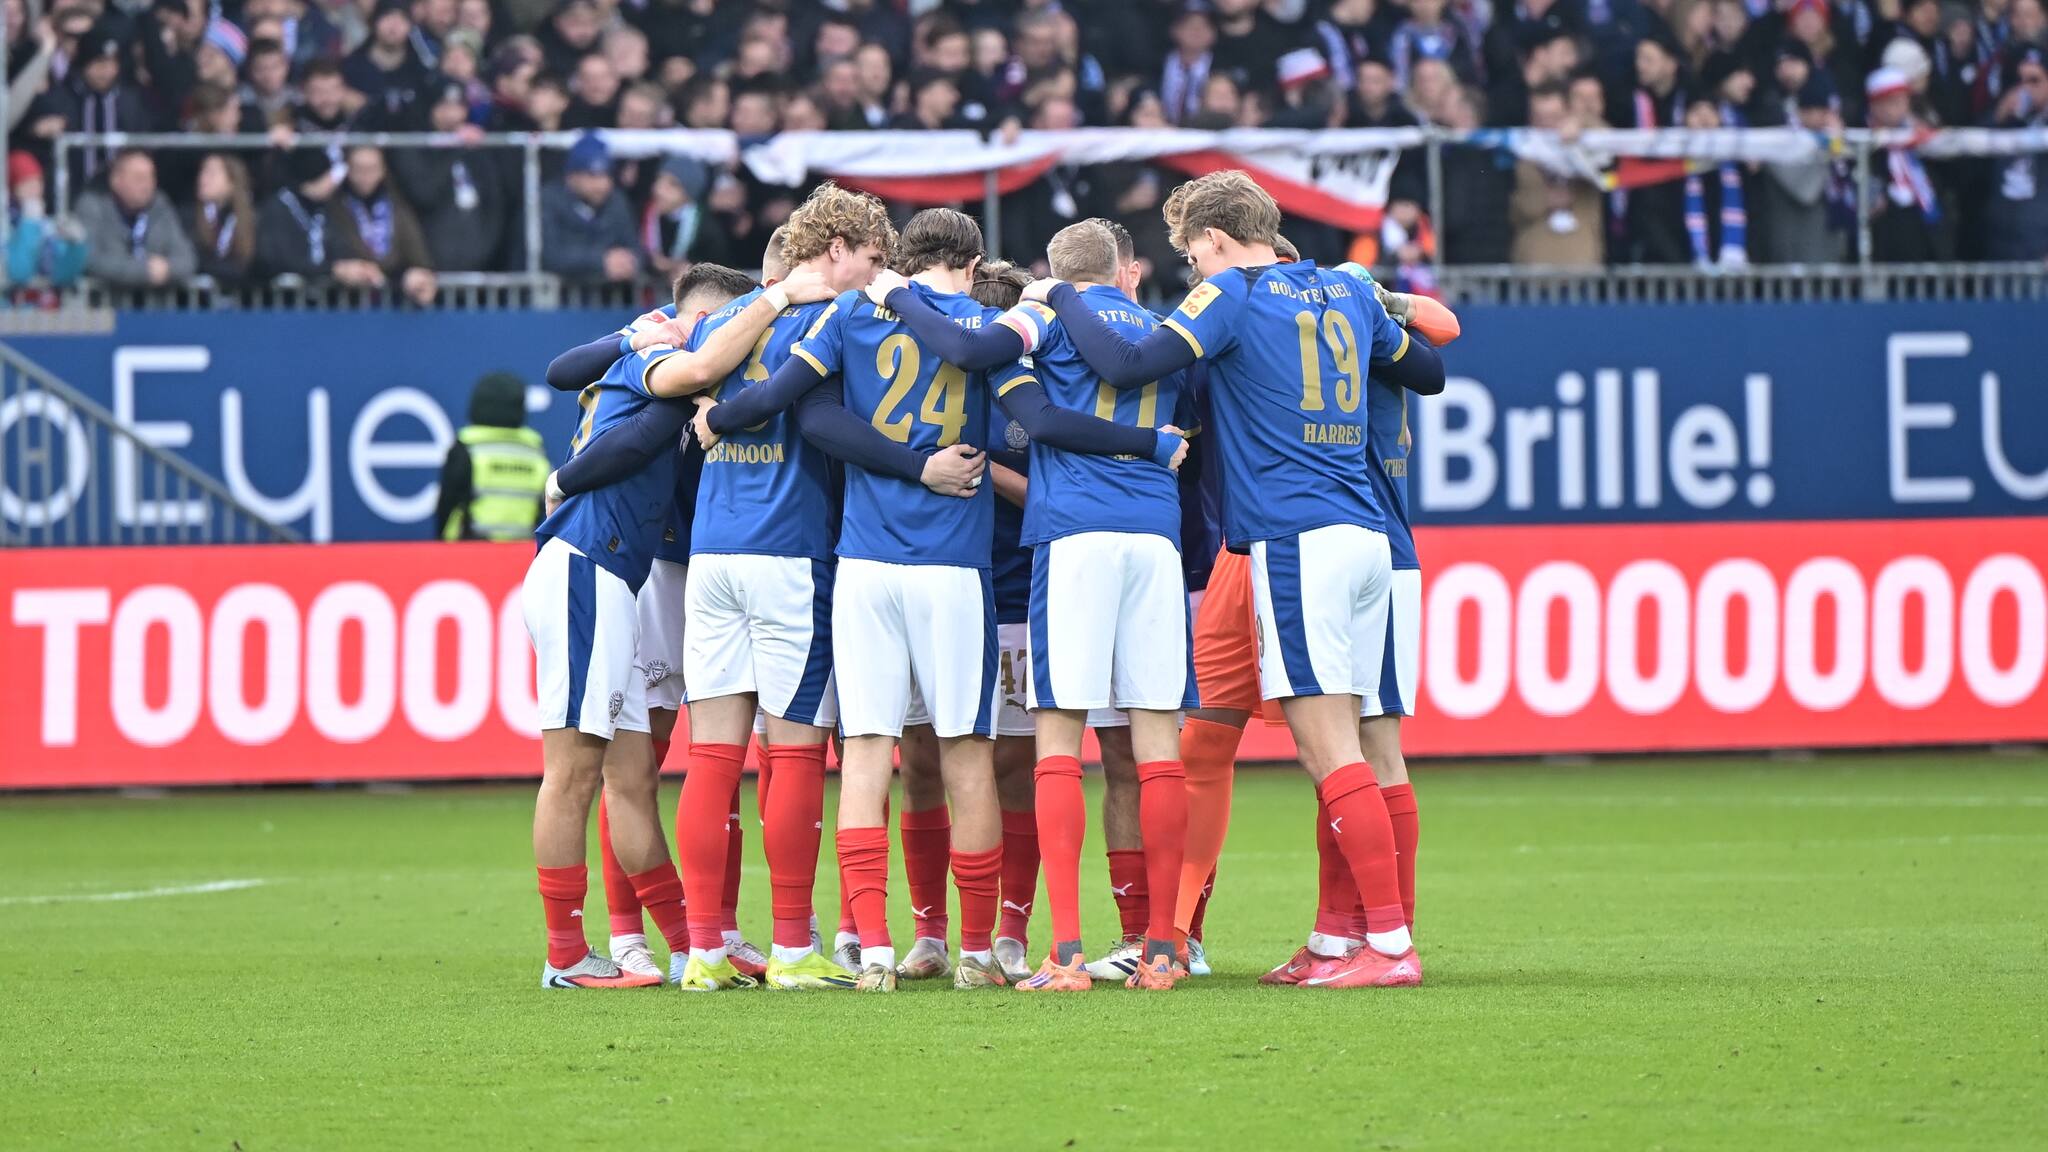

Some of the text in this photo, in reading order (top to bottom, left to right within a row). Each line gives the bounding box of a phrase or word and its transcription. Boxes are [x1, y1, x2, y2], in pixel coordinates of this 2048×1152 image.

[872, 333, 967, 448] 24
[1295, 309, 1361, 413] 19
[1303, 423, 1361, 446] HARRES
[1420, 367, 1775, 512] Brille!
